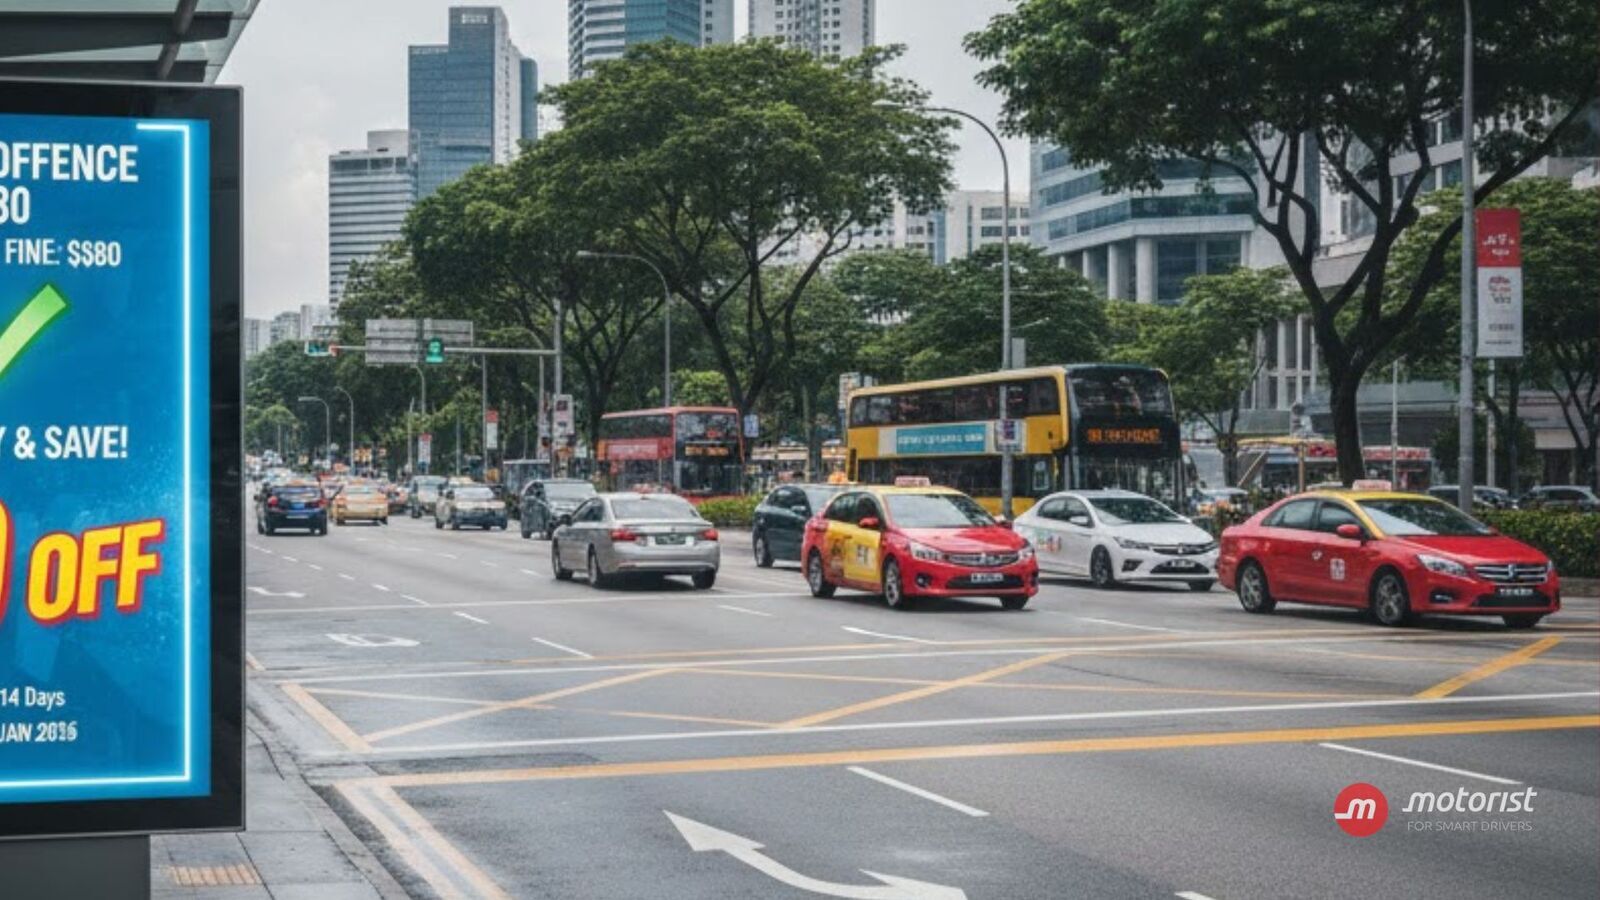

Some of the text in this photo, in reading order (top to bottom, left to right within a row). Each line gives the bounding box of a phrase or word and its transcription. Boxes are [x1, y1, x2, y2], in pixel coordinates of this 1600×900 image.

[14, 426, 36, 459] &
[44, 425, 128, 459] SAVE!
[27, 518, 165, 626] OFF
[25, 686, 66, 711] Days
